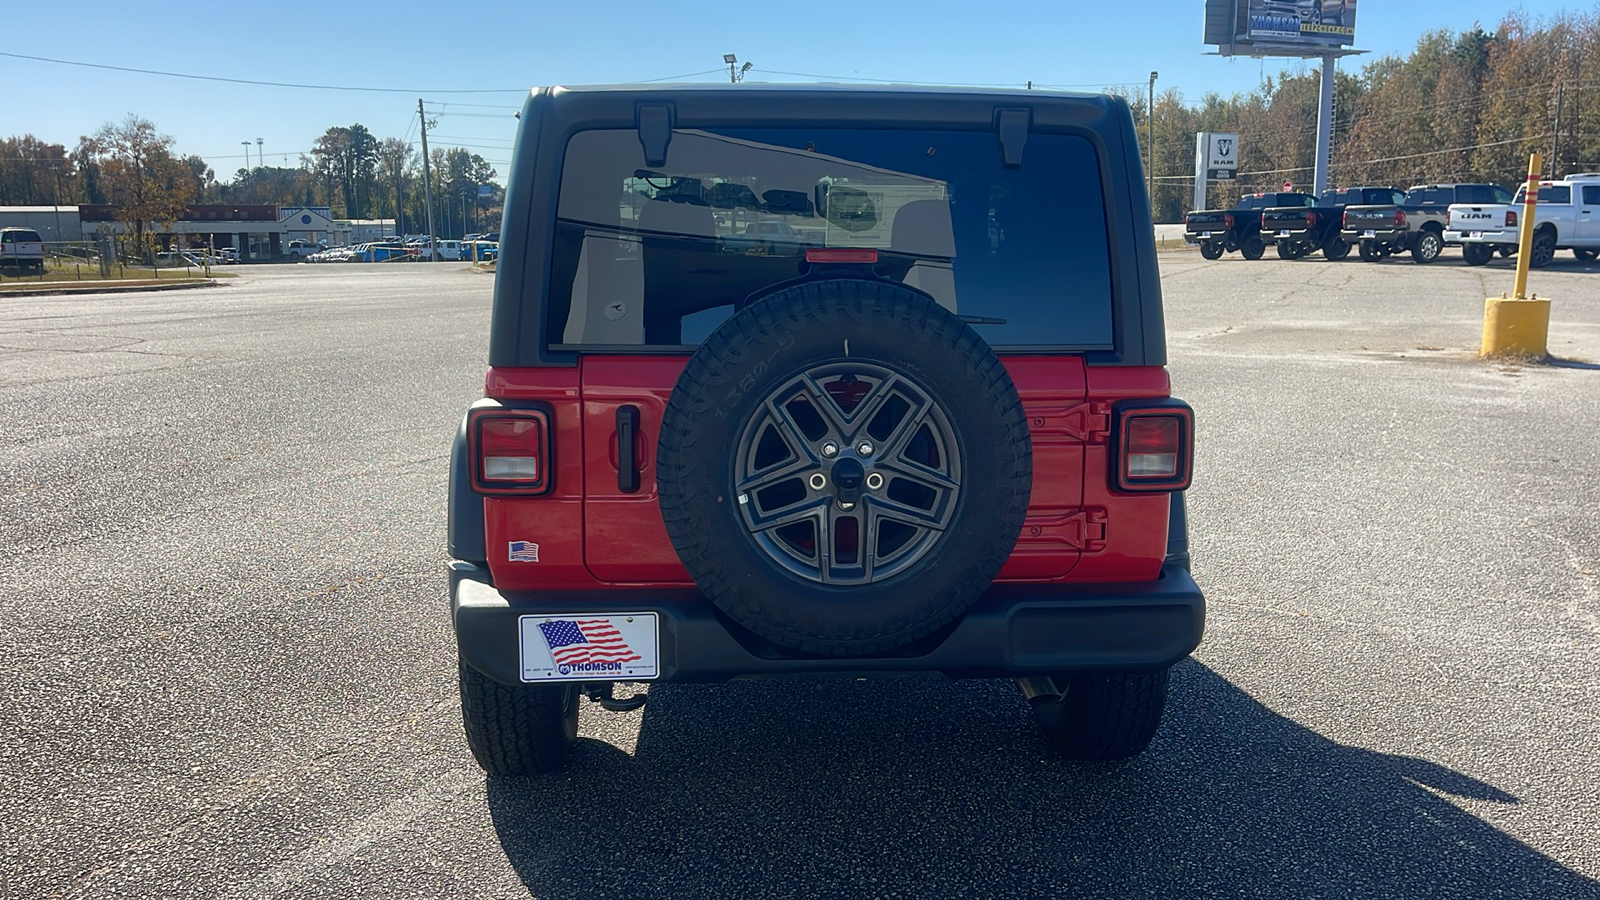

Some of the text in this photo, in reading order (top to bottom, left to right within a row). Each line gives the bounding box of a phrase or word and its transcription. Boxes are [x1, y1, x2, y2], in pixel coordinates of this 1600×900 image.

[1251, 15, 1300, 31] THOMSON
[1300, 25, 1353, 34] JEEPCHEAP.COM
[572, 662, 622, 671] THOMSON
